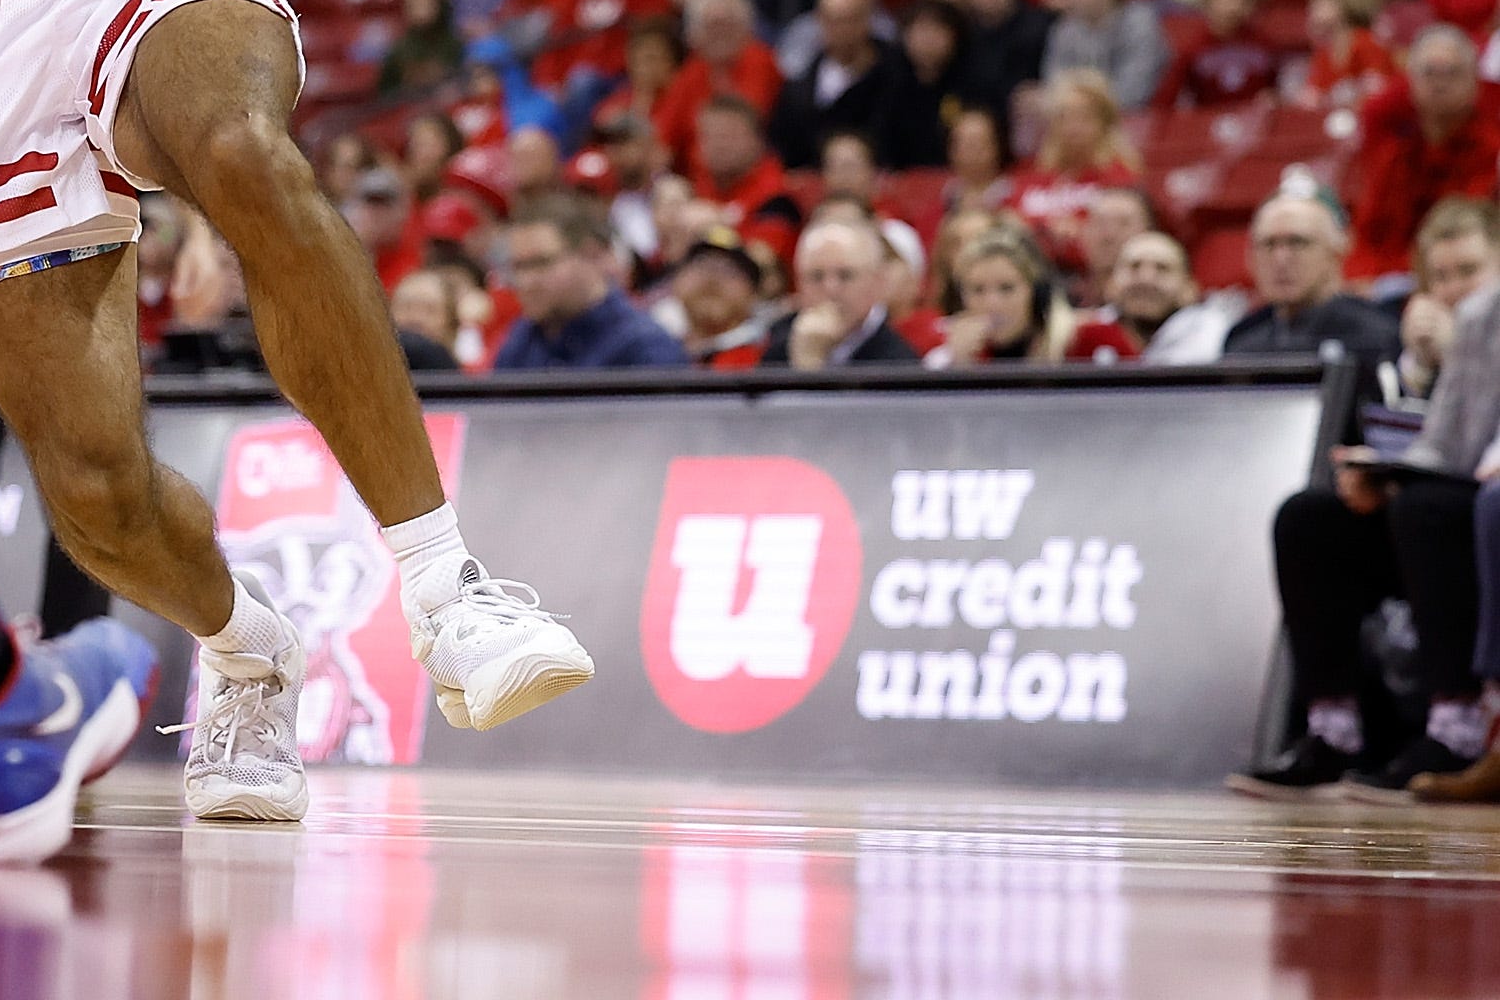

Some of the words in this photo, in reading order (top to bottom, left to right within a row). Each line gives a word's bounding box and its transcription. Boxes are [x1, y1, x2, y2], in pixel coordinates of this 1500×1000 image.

[890, 468, 1035, 540] uw
[869, 536, 1143, 630] credit
[855, 629, 1129, 722] union
